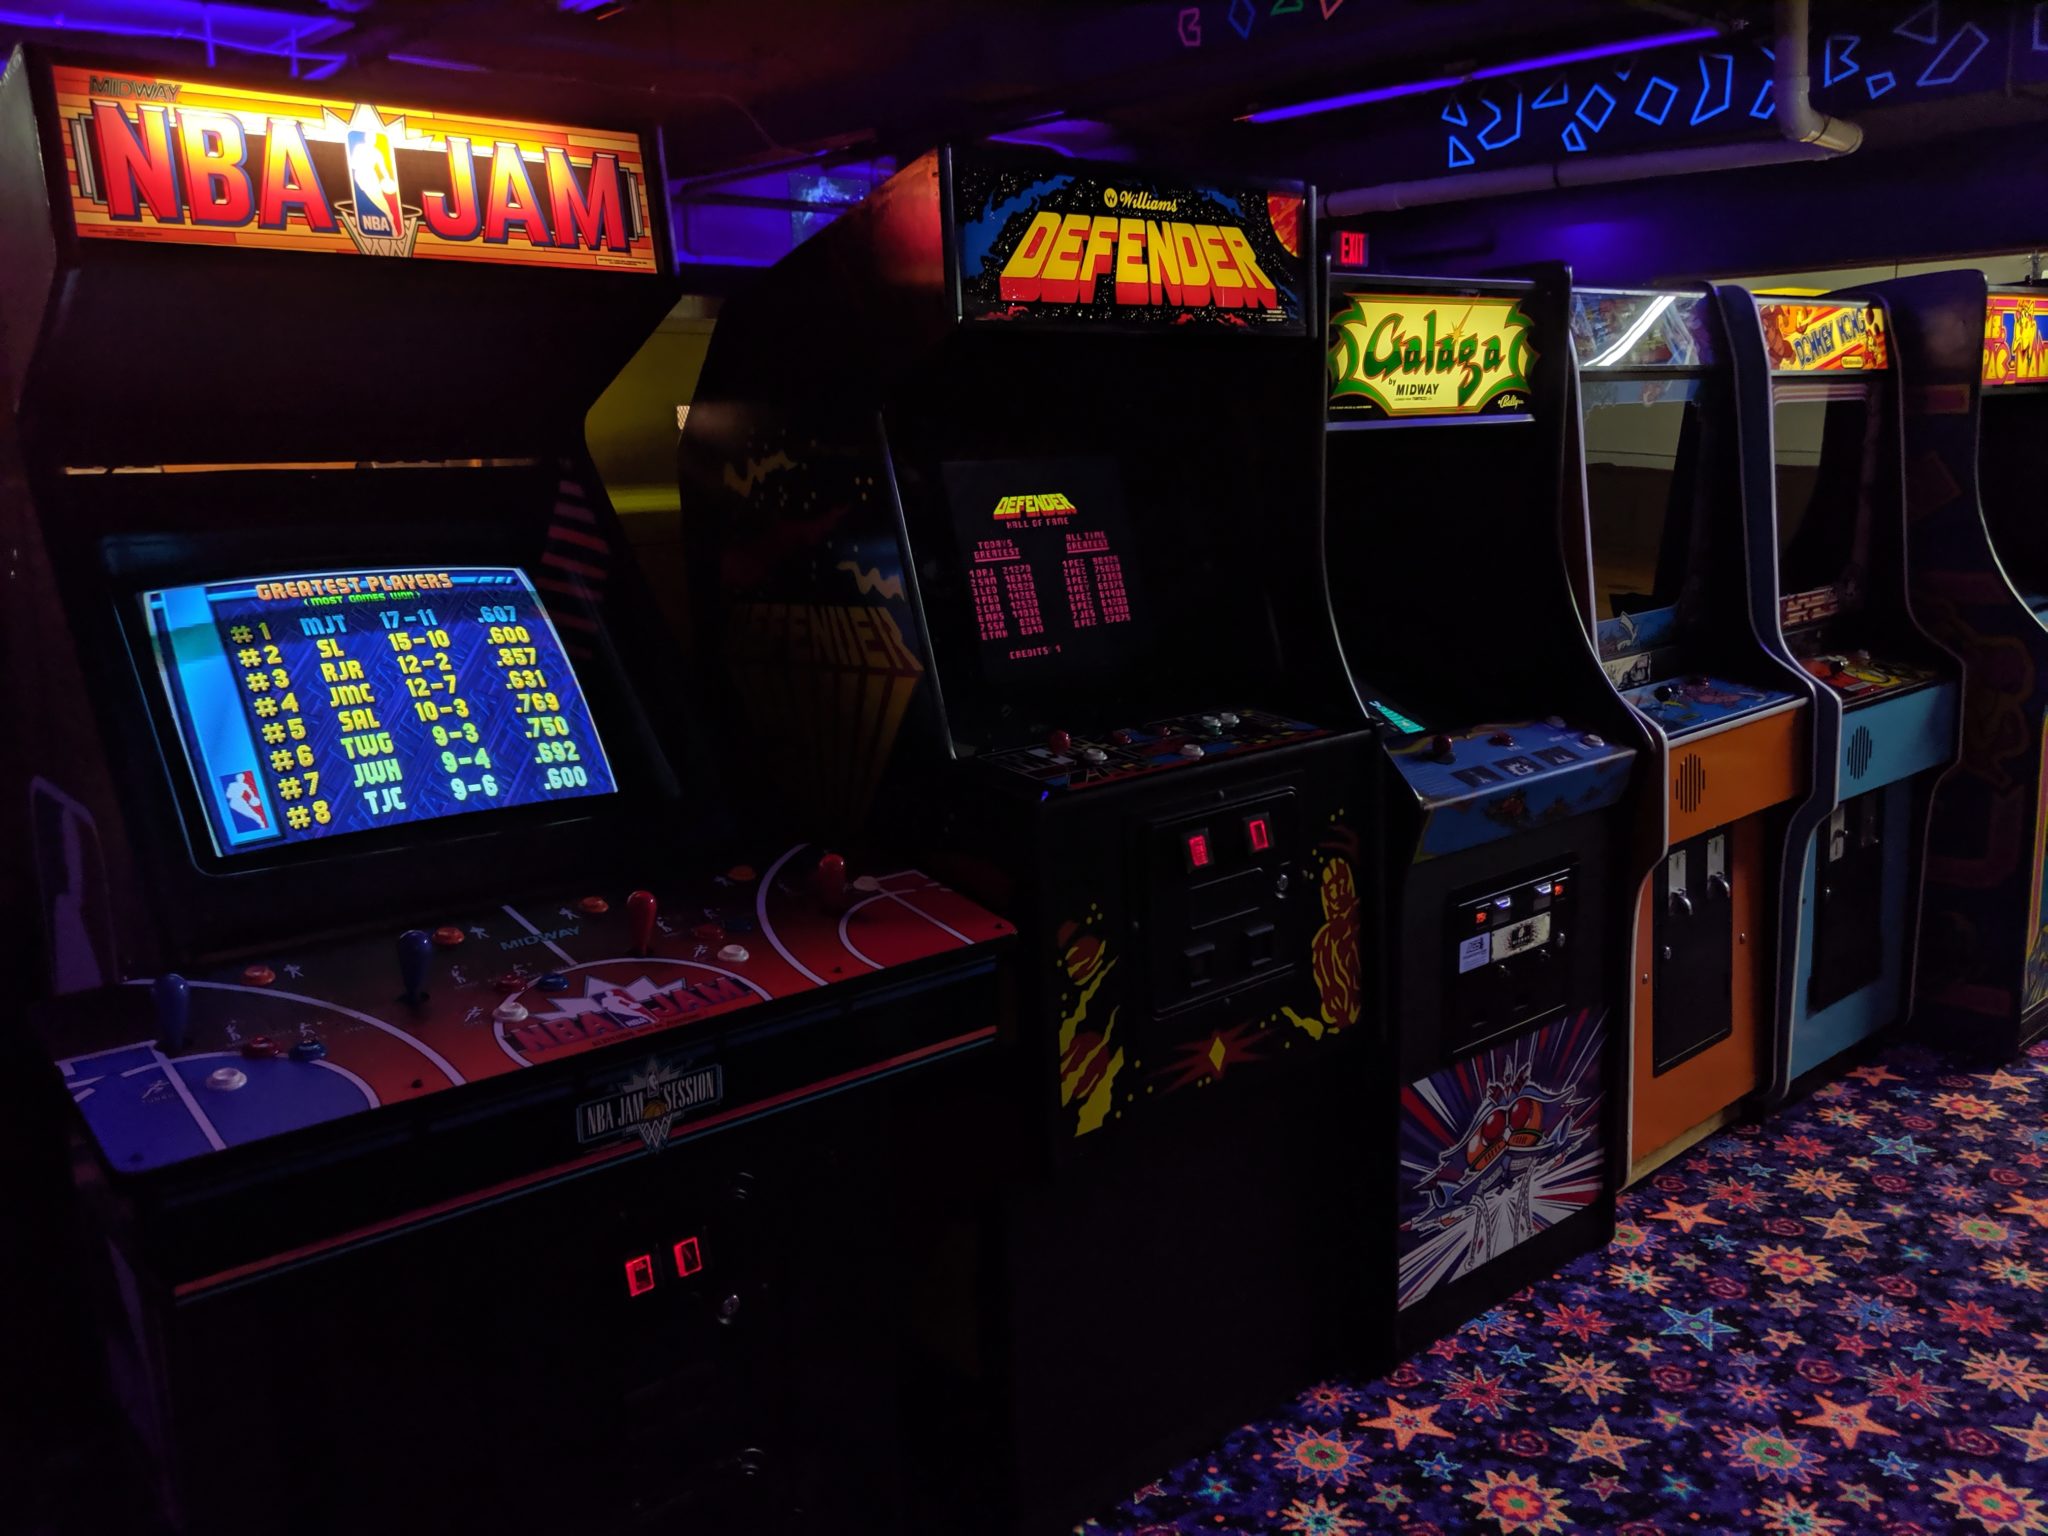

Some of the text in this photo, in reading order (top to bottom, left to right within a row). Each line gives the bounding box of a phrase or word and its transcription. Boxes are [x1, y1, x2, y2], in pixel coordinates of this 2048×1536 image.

[90, 76, 182, 103] MIDWAY
[90, 97, 633, 253] NBA JAM
[1119, 190, 1179, 213] Williams
[362, 215, 391, 232] NBA
[1000, 211, 1278, 310] DEFENDER
[1341, 231, 1365, 266] EXIT
[1793, 307, 1866, 368] DONKEY KONG
[1362, 308, 1507, 408] Galaga
[1388, 377, 1397, 387] by
[1396, 383, 1440, 396] MIDWAY
[1497, 394, 1524, 411] Bally
[993, 493, 1078, 520] DEFENDER
[1006, 517, 1070, 529] HALL OF FAME
[1065, 530, 1106, 542] ALL TIME
[974, 547, 1020, 559] GREATEST
[1066, 539, 1109, 551] GREATEST
[255, 573, 453, 601] GREATEST PLAYERS
[348, 593, 386, 603] GAMES
[300, 615, 347, 637] MJT
[379, 608, 439, 630] 17-11
[477, 605, 518, 625] .607
[316, 637, 346, 659] SL
[388, 629, 451, 652] 15-10
[487, 625, 532, 646] .600
[320, 660, 365, 683] RJR
[397, 652, 453, 675] 12-2
[496, 647, 538, 668] .857
[329, 683, 376, 709] JMC
[406, 674, 457, 698] 12-7
[505, 668, 549, 691] .631
[338, 708, 382, 732] SAL
[414, 698, 470, 722] 10-3
[515, 692, 560, 714] .769
[341, 732, 394, 760] TWG
[432, 722, 480, 747] 9-3
[525, 715, 570, 739] .750
[353, 758, 403, 788] JWH
[441, 746, 491, 774] 9-4
[535, 739, 580, 764] .692
[363, 785, 407, 816] TJC
[450, 773, 499, 801] 9-6
[544, 765, 588, 791] .600
[499, 926, 580, 952] MIDWAY
[509, 1010, 625, 1053] NBA
[649, 976, 753, 1018] JAM
[587, 1070, 716, 1136] NBA JAM SESSION
